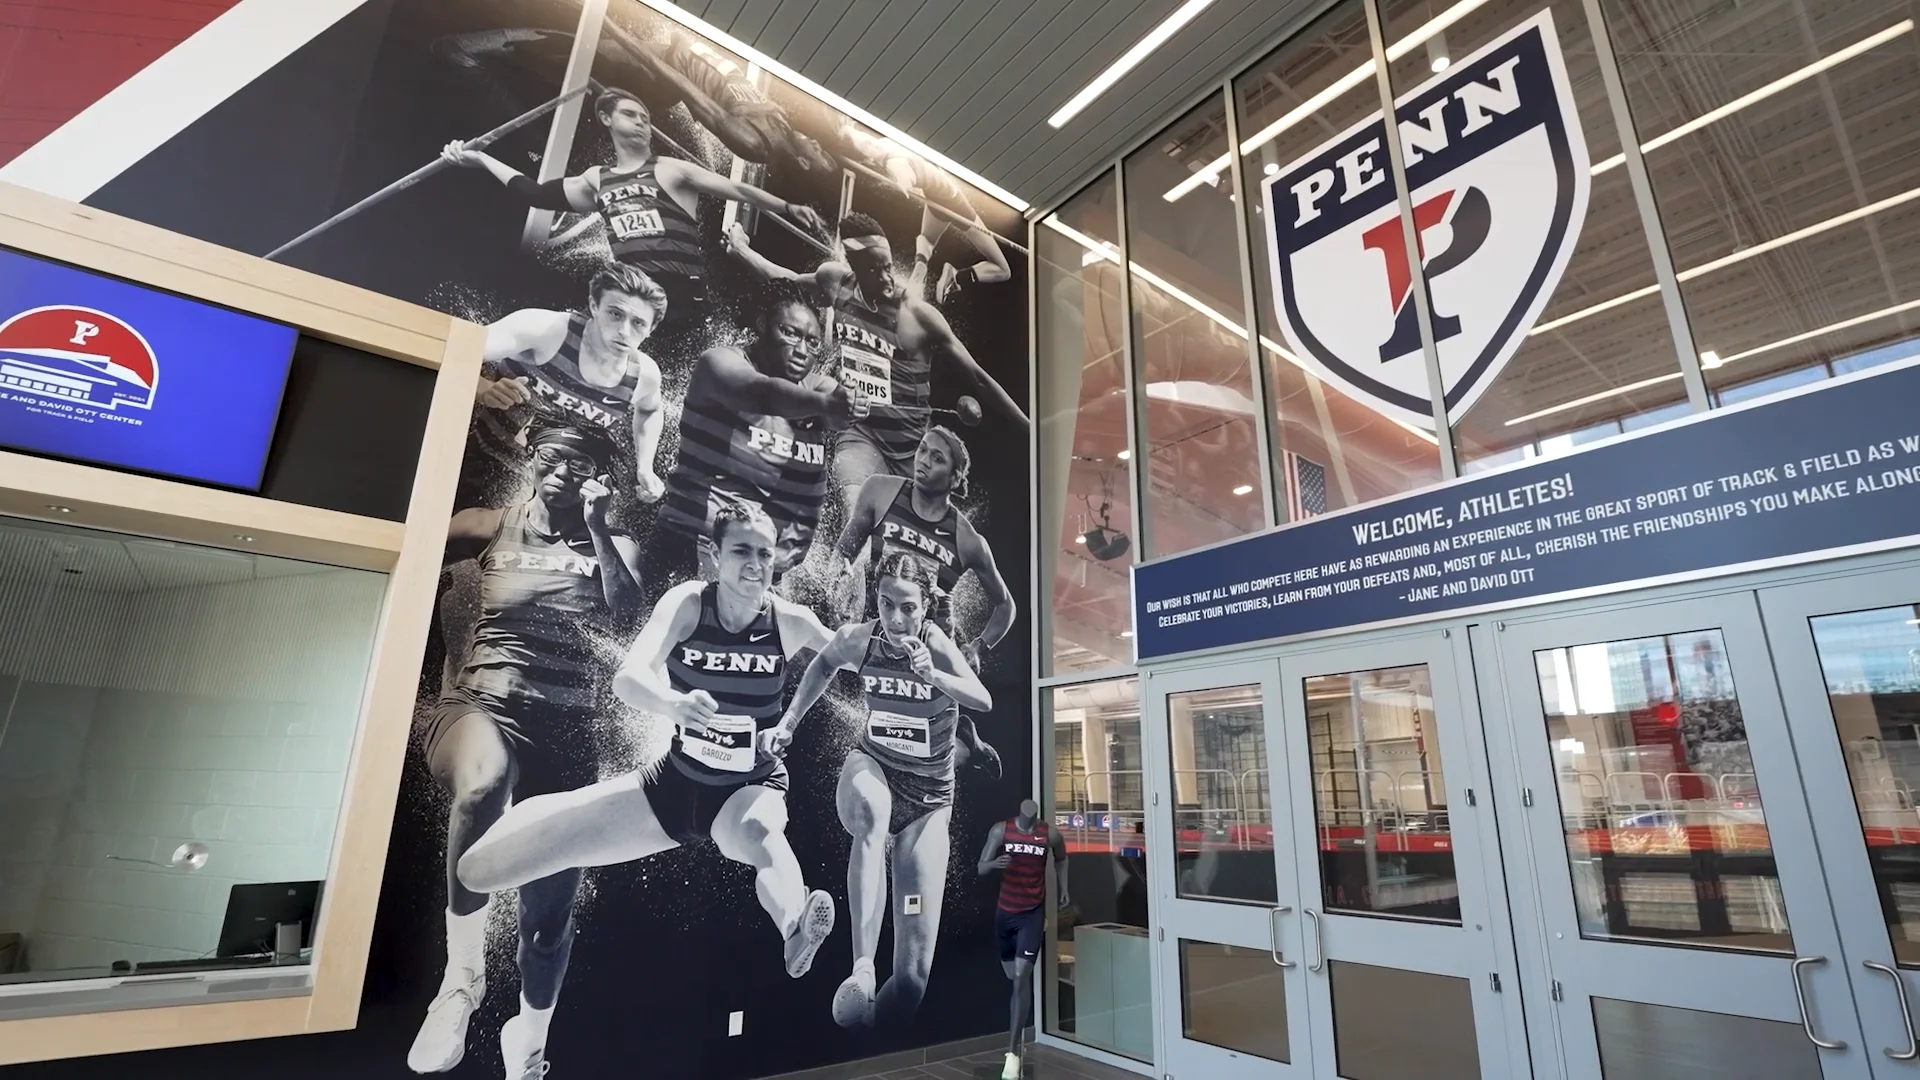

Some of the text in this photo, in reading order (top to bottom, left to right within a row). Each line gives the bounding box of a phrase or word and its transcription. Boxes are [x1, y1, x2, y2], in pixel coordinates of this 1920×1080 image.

[1290, 54, 1522, 229] PENN
[600, 183, 659, 206] PENN
[618, 212, 657, 233] 1241
[1362, 185, 1491, 364] P
[69, 320, 100, 345] P
[836, 322, 897, 359] PENN
[10, 395, 37, 404] AND
[39, 400, 73, 411] DAVID
[75, 407, 98, 417] OTT
[99, 412, 143, 426] CENTER
[532, 376, 618, 428] PENN
[747, 425, 825, 465] PENN
[1352, 472, 1574, 546] WELCOME, ATHLETES!
[1147, 601, 1161, 613] OUR
[1162, 596, 1182, 609] WISH
[1183, 594, 1191, 605] IS
[1191, 590, 1212, 604] THAT
[1212, 587, 1228, 600] ALL
[1230, 582, 1250, 596] WHO
[1251, 572, 1292, 591] COMPETE
[1293, 566, 1319, 582] HERE
[1321, 561, 1347, 577] HAVE
[1349, 558, 1363, 572] AS
[1365, 543, 1430, 568] REWARDING
[1433, 538, 1450, 554] AN
[1452, 520, 1534, 550] EXPERIENCE
[1536, 517, 1552, 532] IN
[1554, 509, 1583, 528] THE
[1585, 498, 1632, 521] GREAT
[1636, 486, 1688, 511] SPORT
[1692, 480, 1714, 499] OF
[1718, 467, 1778, 493] TRACK
[1783, 462, 1797, 479] &
[1801, 448, 1862, 476] FIELD
[1867, 441, 1895, 463] AS
[883, 521, 955, 566] PENN
[1158, 612, 1201, 628] CELEBRATE
[1201, 606, 1224, 619] YOUR
[1224, 598, 1272, 615] VICTORIES,
[1273, 591, 1303, 606] LEARN
[1304, 584, 1332, 600] FROM
[1333, 578, 1361, 595] YOUR
[1363, 568, 1410, 589] DEFEATS
[1413, 563, 1442, 580] AND,
[1444, 554, 1477, 573] MOST
[1479, 551, 1496, 567] OF
[1500, 546, 1532, 563] ALL,
[1535, 531, 1598, 555] CHERISH
[1600, 524, 1631, 543] THE
[1633, 501, 1748, 537] FRIENDSHIPS
[1750, 492, 1789, 514] YOU
[1792, 480, 1850, 506] MAKE
[492, 551, 599, 577] PENN
[1408, 585, 1440, 602] JANE
[1442, 580, 1467, 597] AND
[1470, 573, 1508, 592] DAVID
[1510, 568, 1535, 585] OTT
[681, 647, 779, 674] PENN
[863, 675, 934, 700] PENN
[886, 727, 904, 738] Ivy
[701, 746, 732, 761] GAROZZO
[1005, 843, 1045, 856] PENN
